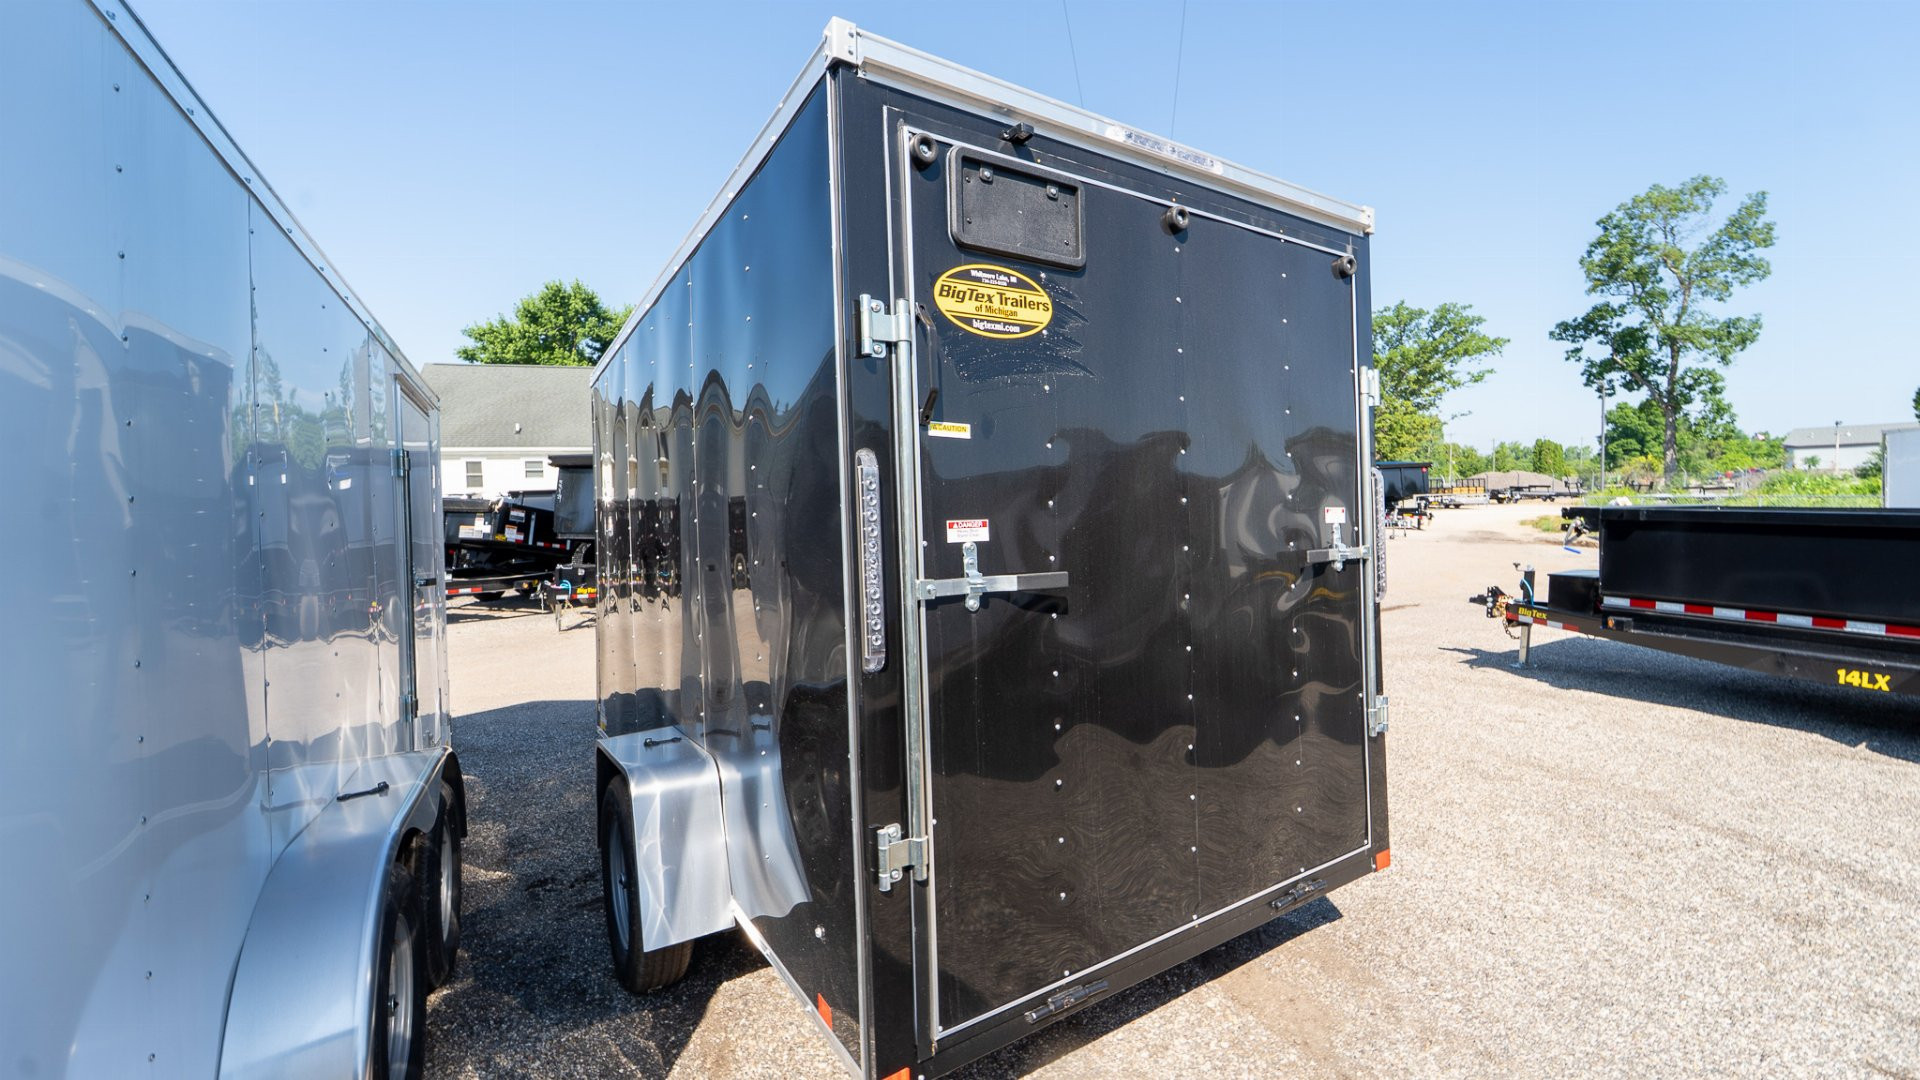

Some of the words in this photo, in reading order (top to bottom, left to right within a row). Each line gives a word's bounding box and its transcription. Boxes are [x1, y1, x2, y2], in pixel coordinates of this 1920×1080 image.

[938, 284, 995, 304] BigTex
[996, 291, 1050, 312] Trailers
[974, 304, 983, 312] of
[985, 305, 1018, 317] Michigan
[972, 319, 1020, 333] bigtexmi.com
[938, 422, 967, 433] CAUTION
[1836, 668, 1892, 692] 14LX
